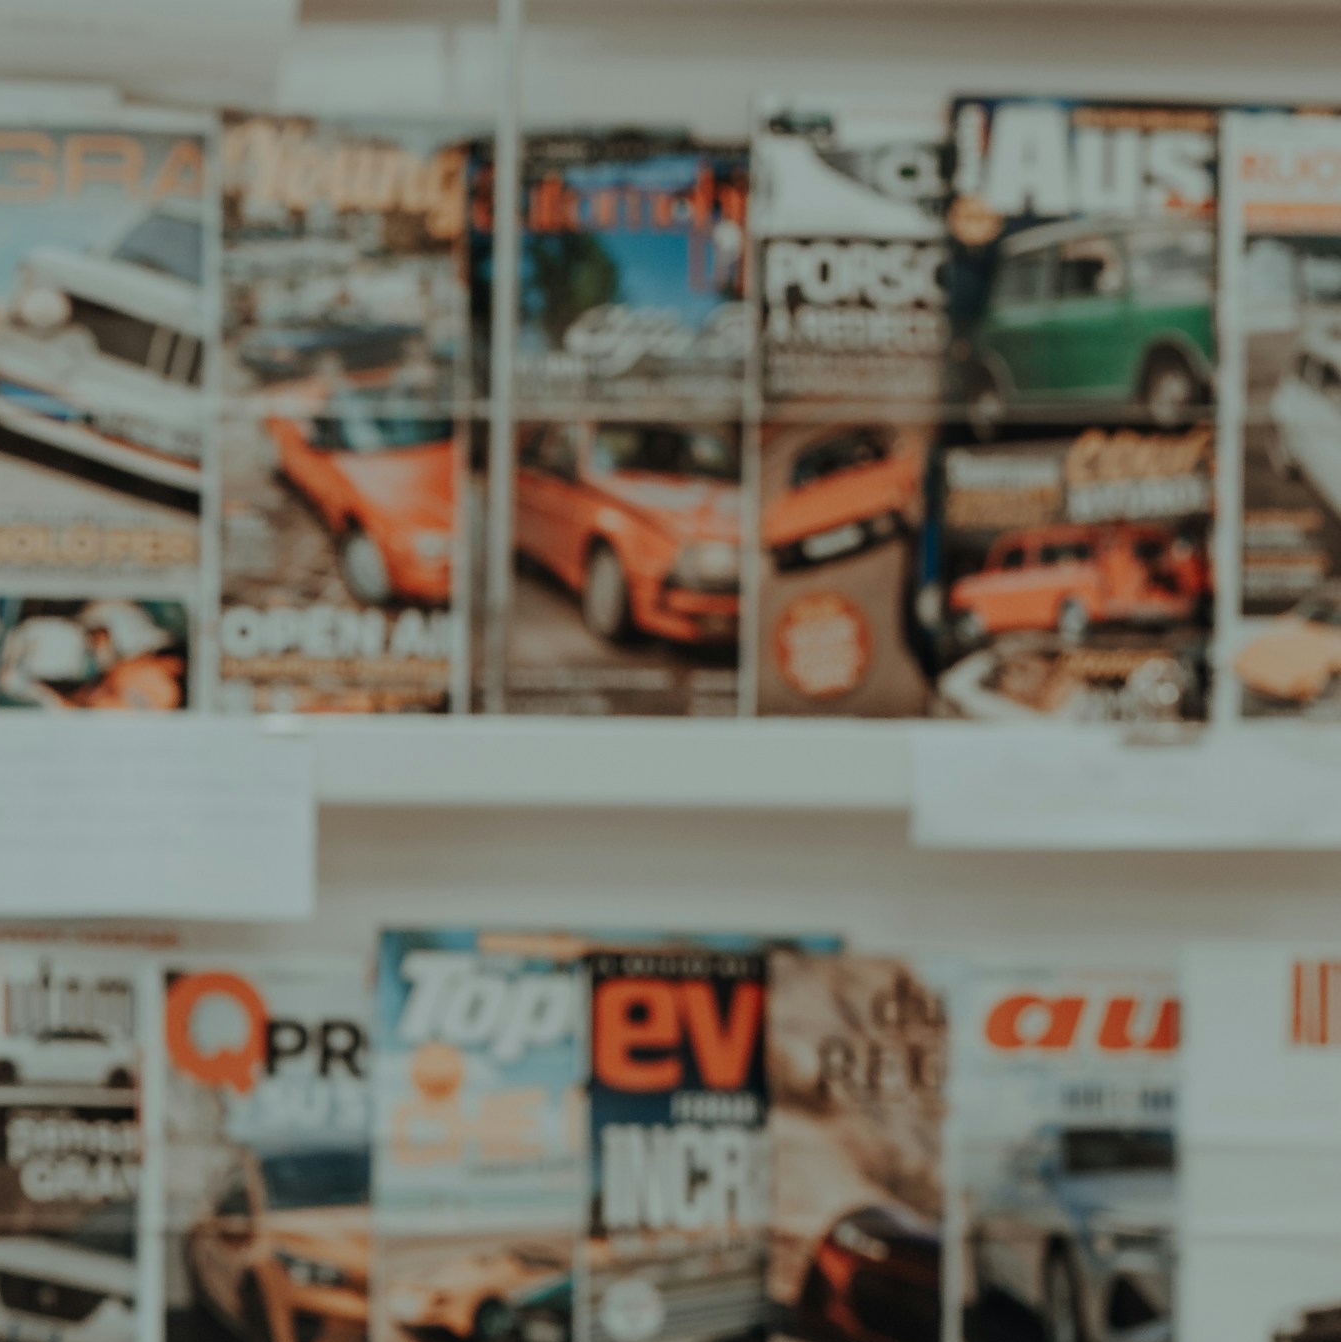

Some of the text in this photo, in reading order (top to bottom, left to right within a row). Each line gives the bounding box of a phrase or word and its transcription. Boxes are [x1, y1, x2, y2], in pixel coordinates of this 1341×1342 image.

[400, 950, 576, 1059] Top
[595, 977, 763, 1093] ev
[983, 992, 1180, 1053] au
